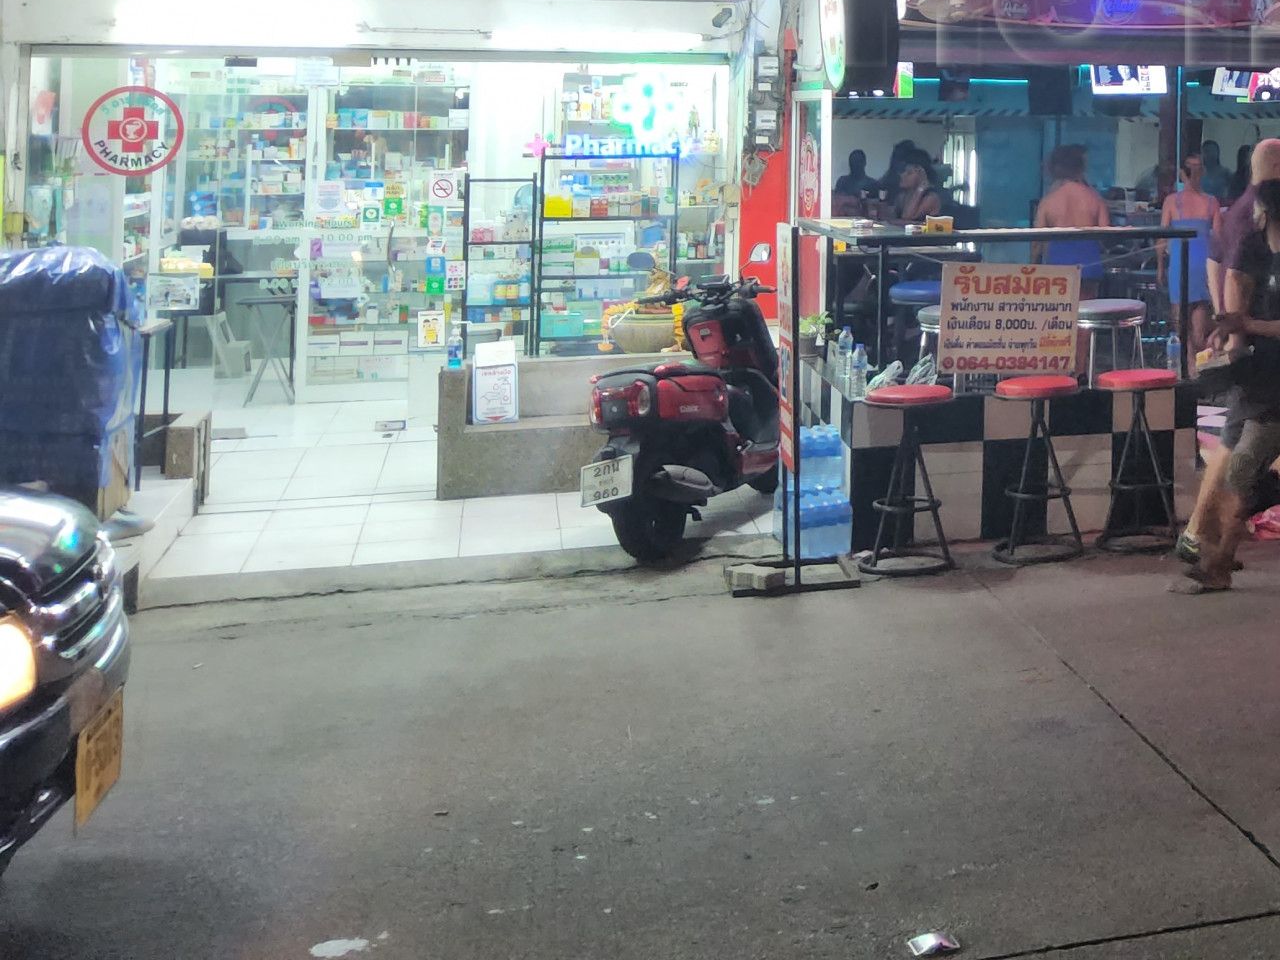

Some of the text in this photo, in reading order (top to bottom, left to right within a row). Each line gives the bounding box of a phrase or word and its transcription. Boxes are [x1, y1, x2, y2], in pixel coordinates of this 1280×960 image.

[94, 140, 169, 167] PHARMACY
[954, 266, 1067, 295] รับสมัคร
[951, 297, 994, 311] พนักงาน
[947, 315, 990, 330] เงินเดือน
